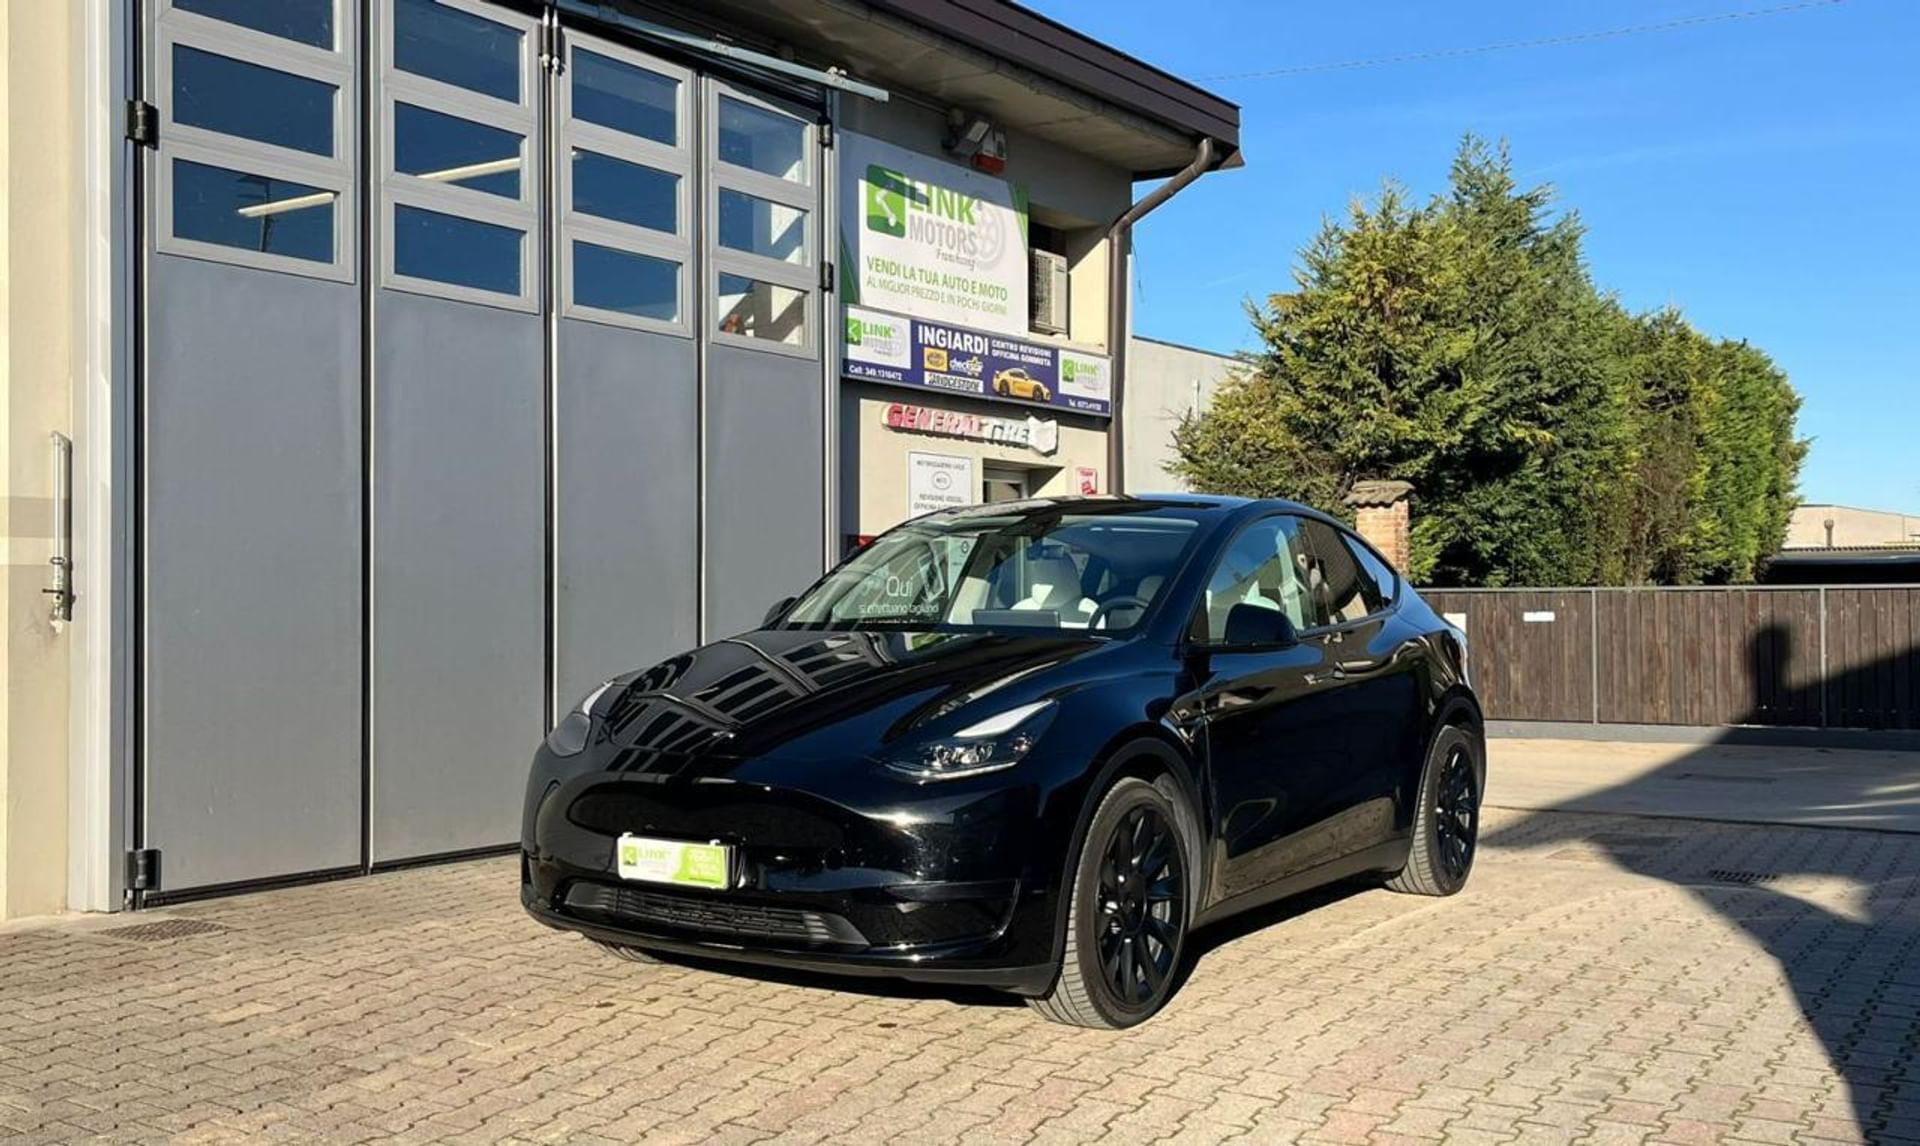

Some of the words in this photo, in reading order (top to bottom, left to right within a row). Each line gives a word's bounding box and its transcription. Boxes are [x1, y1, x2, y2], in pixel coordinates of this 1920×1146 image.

[909, 179, 976, 226] LINK
[909, 214, 977, 256] MOTORS
[866, 255, 900, 277] VENDI
[902, 264, 916, 280] LA
[918, 268, 939, 285] TUA
[942, 273, 969, 293] AUTO
[971, 279, 977, 294] E
[979, 282, 1008, 301] MOTO
[866, 275, 878, 288] AL
[879, 278, 910, 295] MIGLIOR
[911, 285, 940, 301] PREZZO
[946, 292, 956, 305] IN
[957, 294, 979, 311] POCHI
[862, 321, 893, 339] LINK
[917, 324, 989, 356] INGIARDI
[991, 339, 1018, 352] CENTRO
[991, 349, 1020, 361] OFFICINA
[886, 575, 914, 598] Qui
